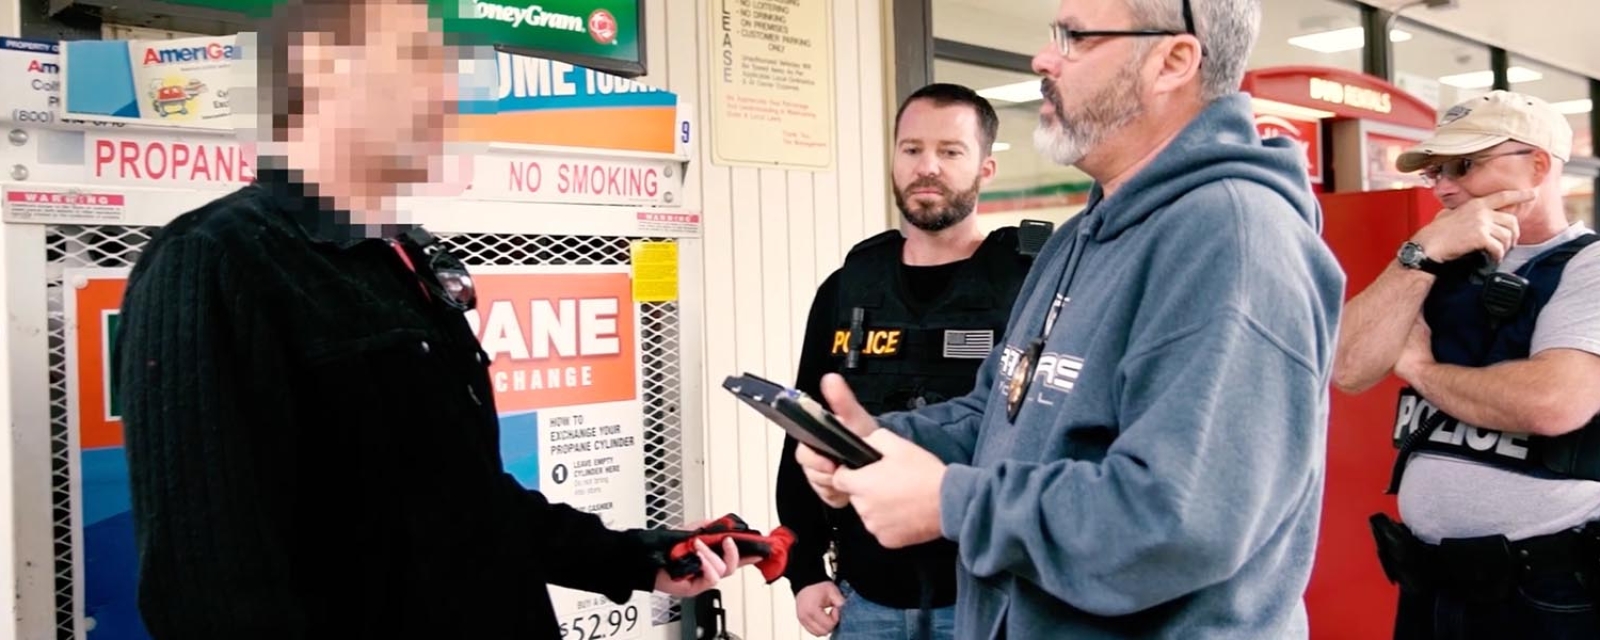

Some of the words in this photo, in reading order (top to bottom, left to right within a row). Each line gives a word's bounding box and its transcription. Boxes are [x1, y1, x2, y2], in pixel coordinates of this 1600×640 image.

[753, 10, 788, 24] DRINKING
[740, 19, 752, 28] ON
[754, 21, 789, 34] PREMISES
[722, 0, 733, 83] LEASE
[741, 29, 780, 41] CUSTOMER
[782, 35, 812, 47] PARKING
[143, 43, 234, 65] AmeriGa
[28, 59, 59, 74] Am
[508, 161, 542, 192] NO
[557, 163, 658, 198] SMOKING
[24, 193, 109, 205] WARNING
[832, 329, 901, 355] POICE
[494, 365, 592, 392] CHANGE
[550, 417, 570, 427] HOW
[573, 415, 584, 425] TO
[550, 427, 597, 442] EXCHANGE
[599, 425, 621, 435] YOUR
[550, 442, 591, 455] PROPANE
[594, 436, 635, 450] CYLINDER
[554, 465, 566, 483] 1
[574, 467, 604, 478] CYLINDER
